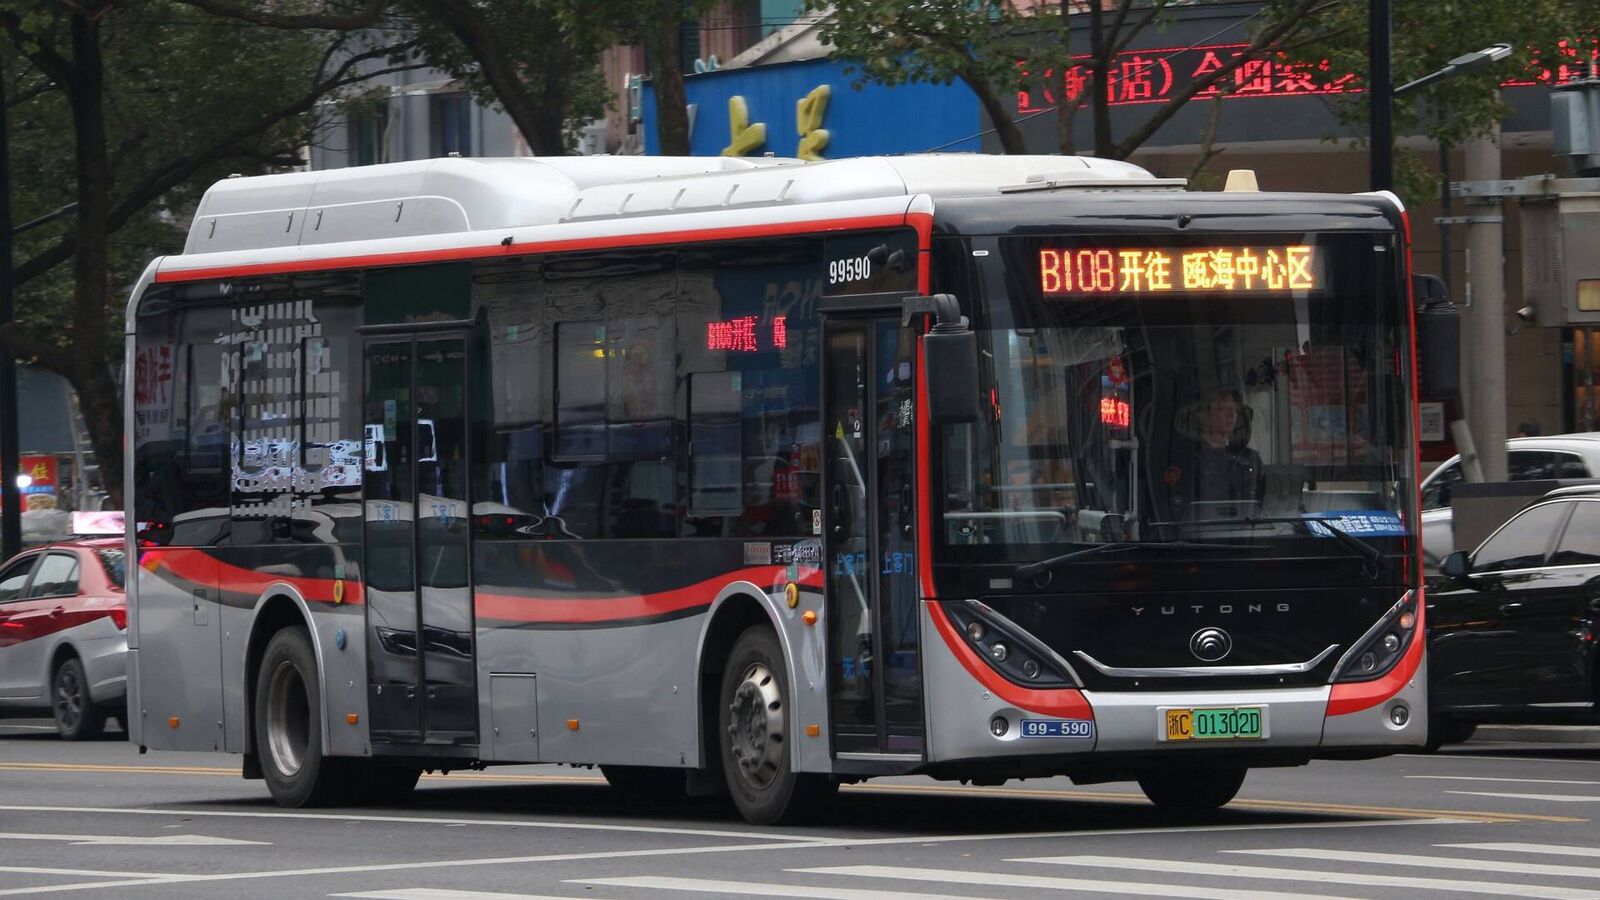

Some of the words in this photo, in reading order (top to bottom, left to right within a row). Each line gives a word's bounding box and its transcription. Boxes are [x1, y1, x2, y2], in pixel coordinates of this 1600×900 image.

[829, 255, 872, 285] 99590
[1182, 247, 1312, 290] 瓯海中心区
[882, 552, 914, 576] 上客门
[1131, 604, 1290, 615] YUTONG
[1028, 721, 1089, 736] 99-590
[1198, 713, 1260, 735] 01302D
